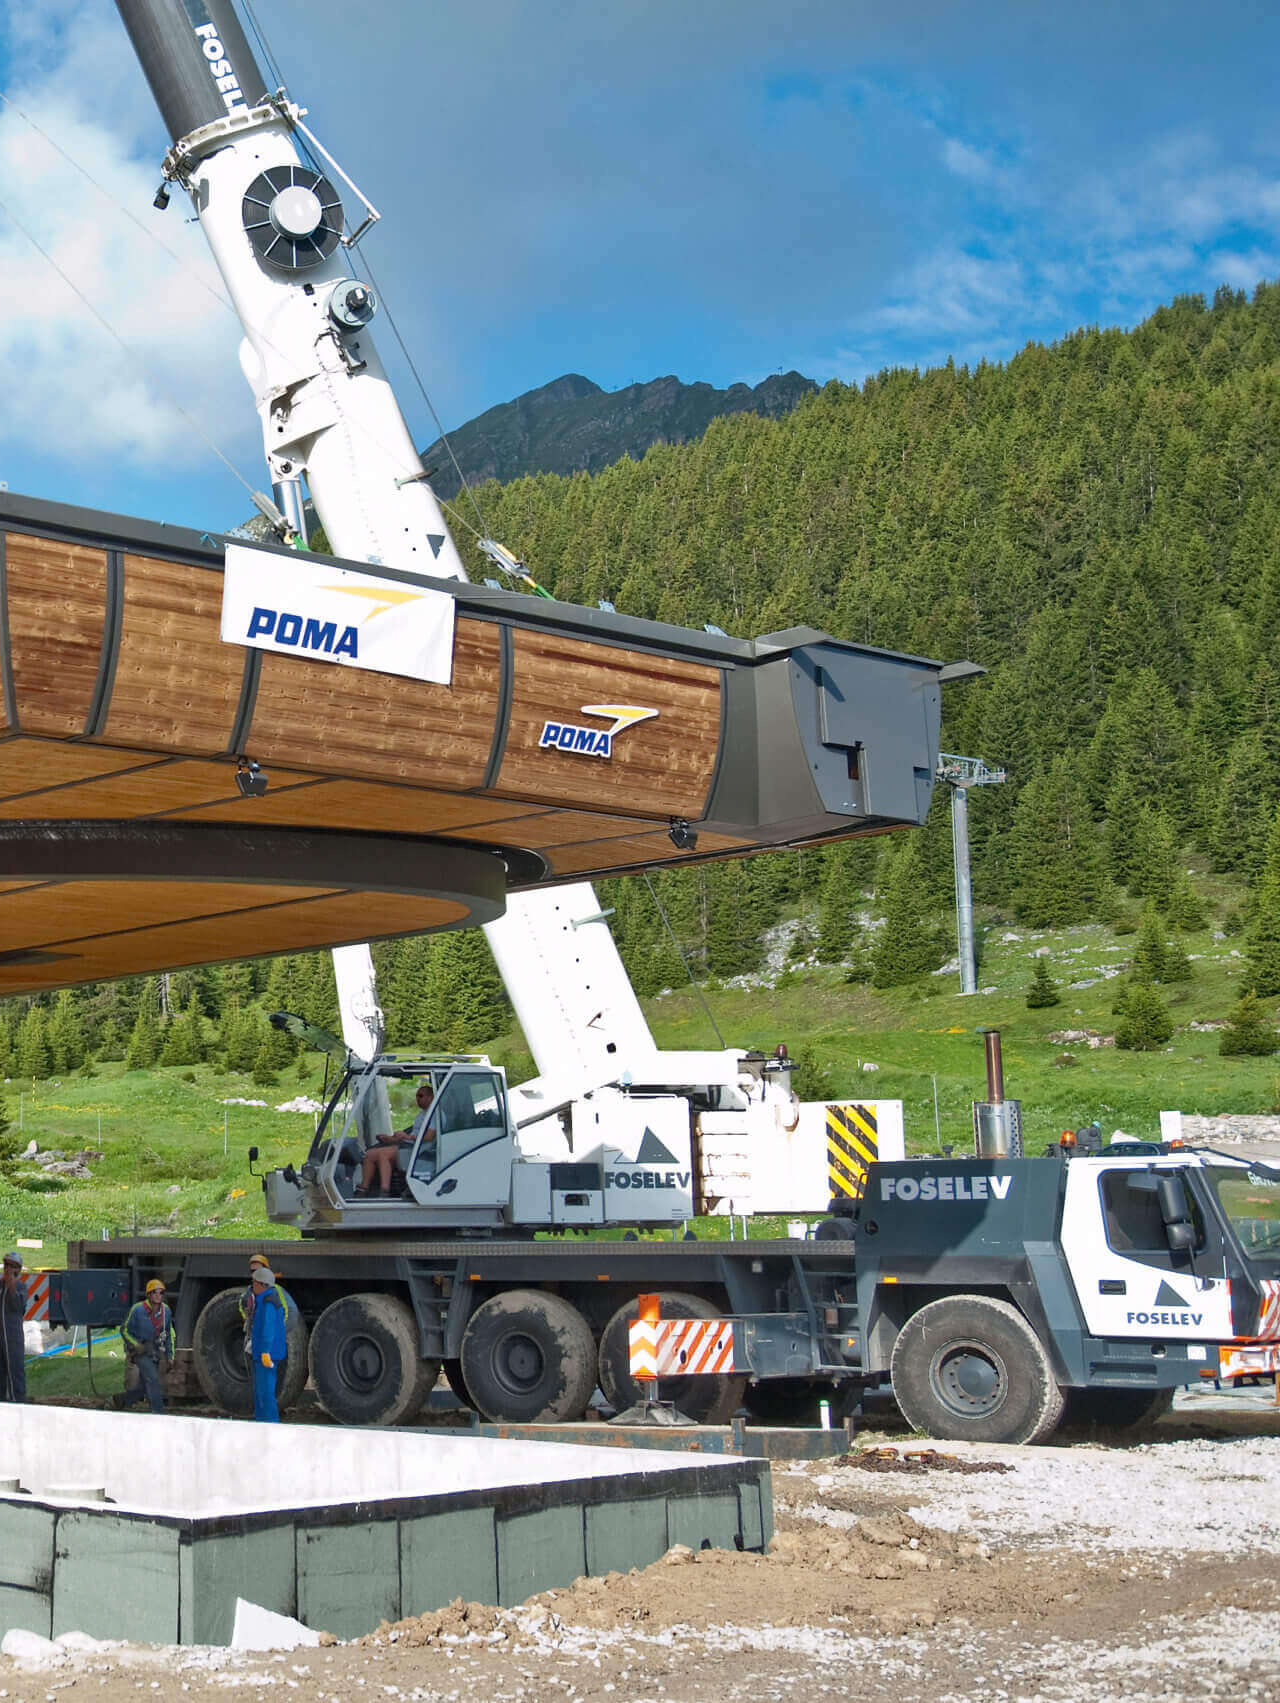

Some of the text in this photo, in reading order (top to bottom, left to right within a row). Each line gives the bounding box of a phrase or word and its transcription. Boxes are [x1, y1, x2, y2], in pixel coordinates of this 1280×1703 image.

[246, 606, 359, 659] POMA
[542, 724, 609, 754] POMA
[604, 1172, 690, 1189] FOSELEV
[880, 1176, 1012, 1200] FOSELEV
[1127, 1312, 1203, 1325] FOSELEV
